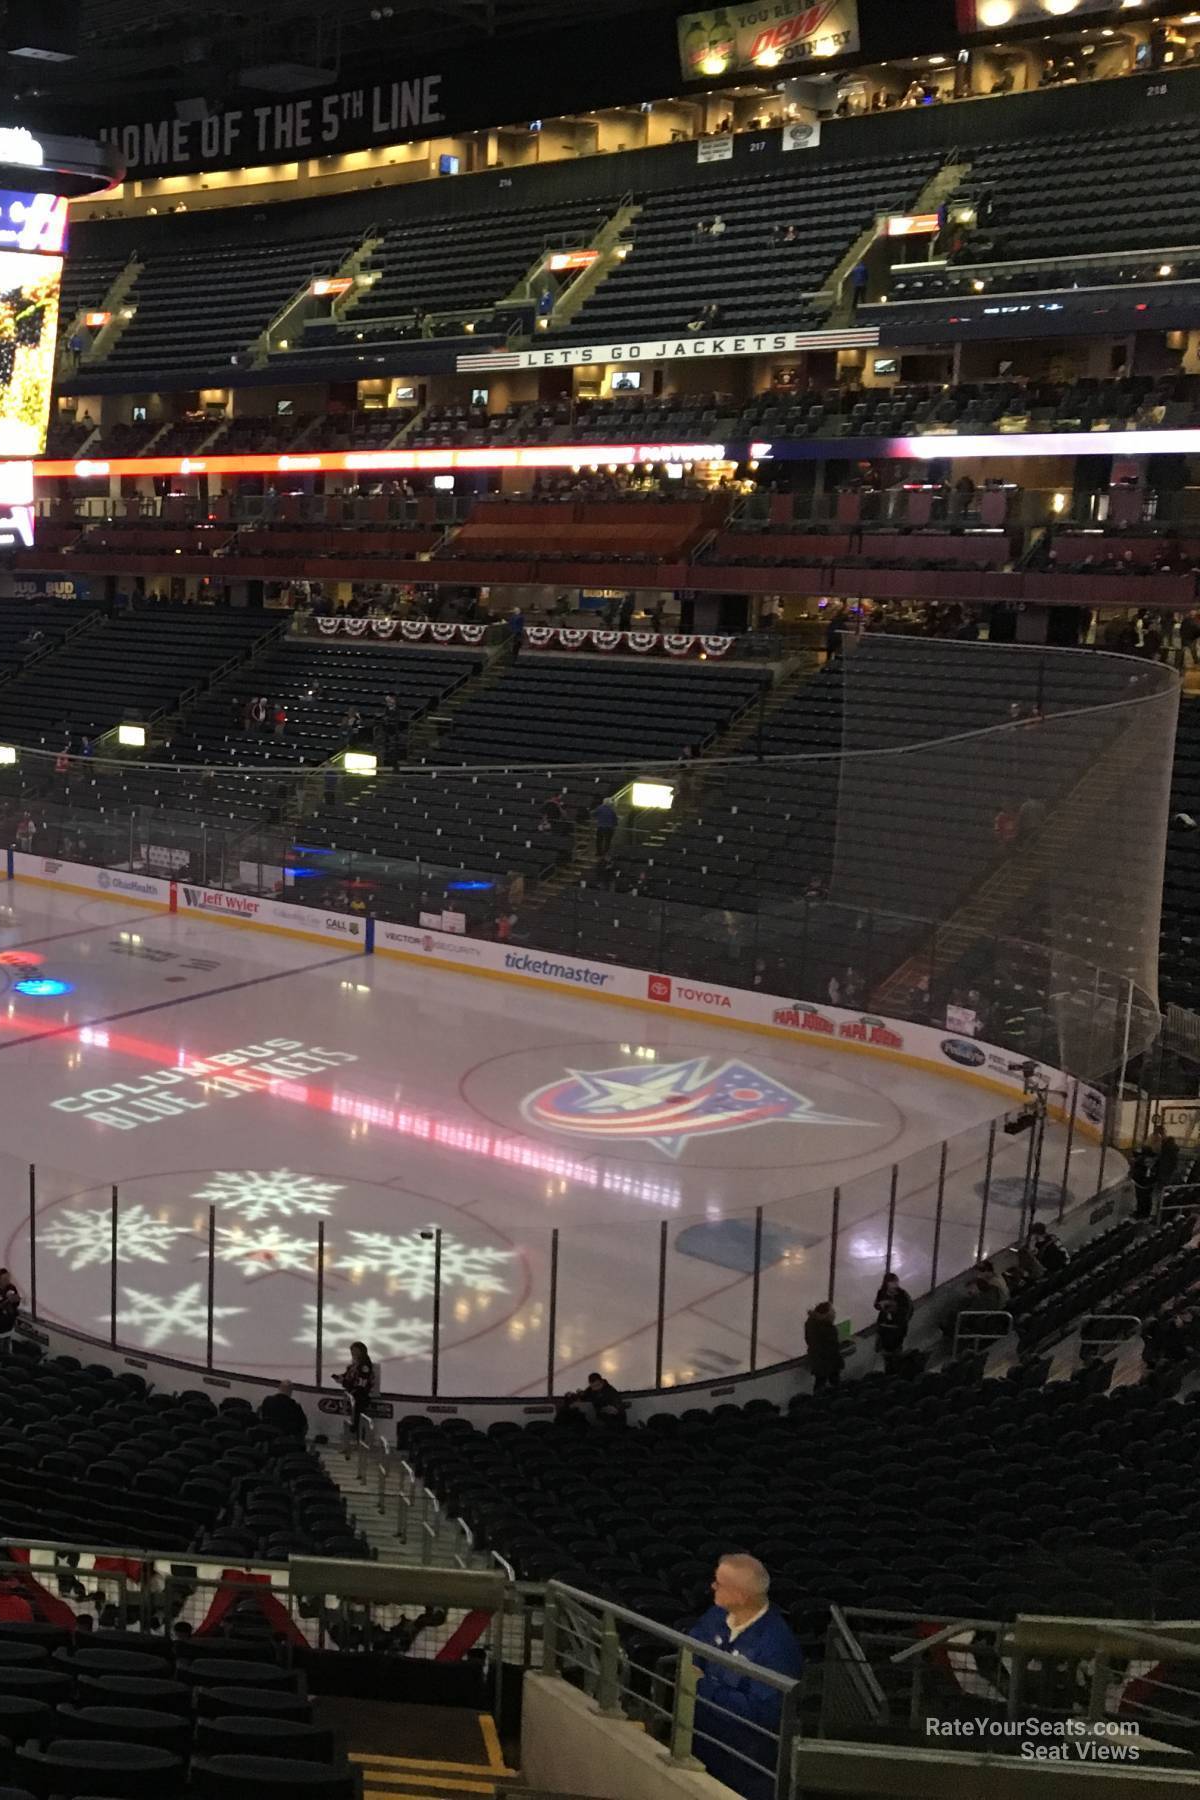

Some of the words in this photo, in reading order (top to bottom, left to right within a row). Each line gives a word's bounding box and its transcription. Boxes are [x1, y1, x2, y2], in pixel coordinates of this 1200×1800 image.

[202, 110, 243, 159] OF
[253, 100, 313, 153] THE
[321, 89, 364, 142] 5TH
[749, 141, 766, 152] 217
[528, 348, 593, 366] LET'S
[611, 346, 641, 359] GO
[656, 335, 787, 356] JACKETS
[112, 876, 159, 896] OhioHealth
[202, 890, 224, 906] Jeff
[225, 894, 261, 914] Wyler
[326, 917, 347, 931] CALL
[385, 931, 422, 945] VECTOR
[504, 952, 609, 987] ticketmaster
[676, 986, 732, 1009] TOYOTA
[50, 1037, 303, 1113] COLUMBUS
[83, 1090, 209, 1130] BLUE
[194, 1046, 359, 1099] JACKETS
